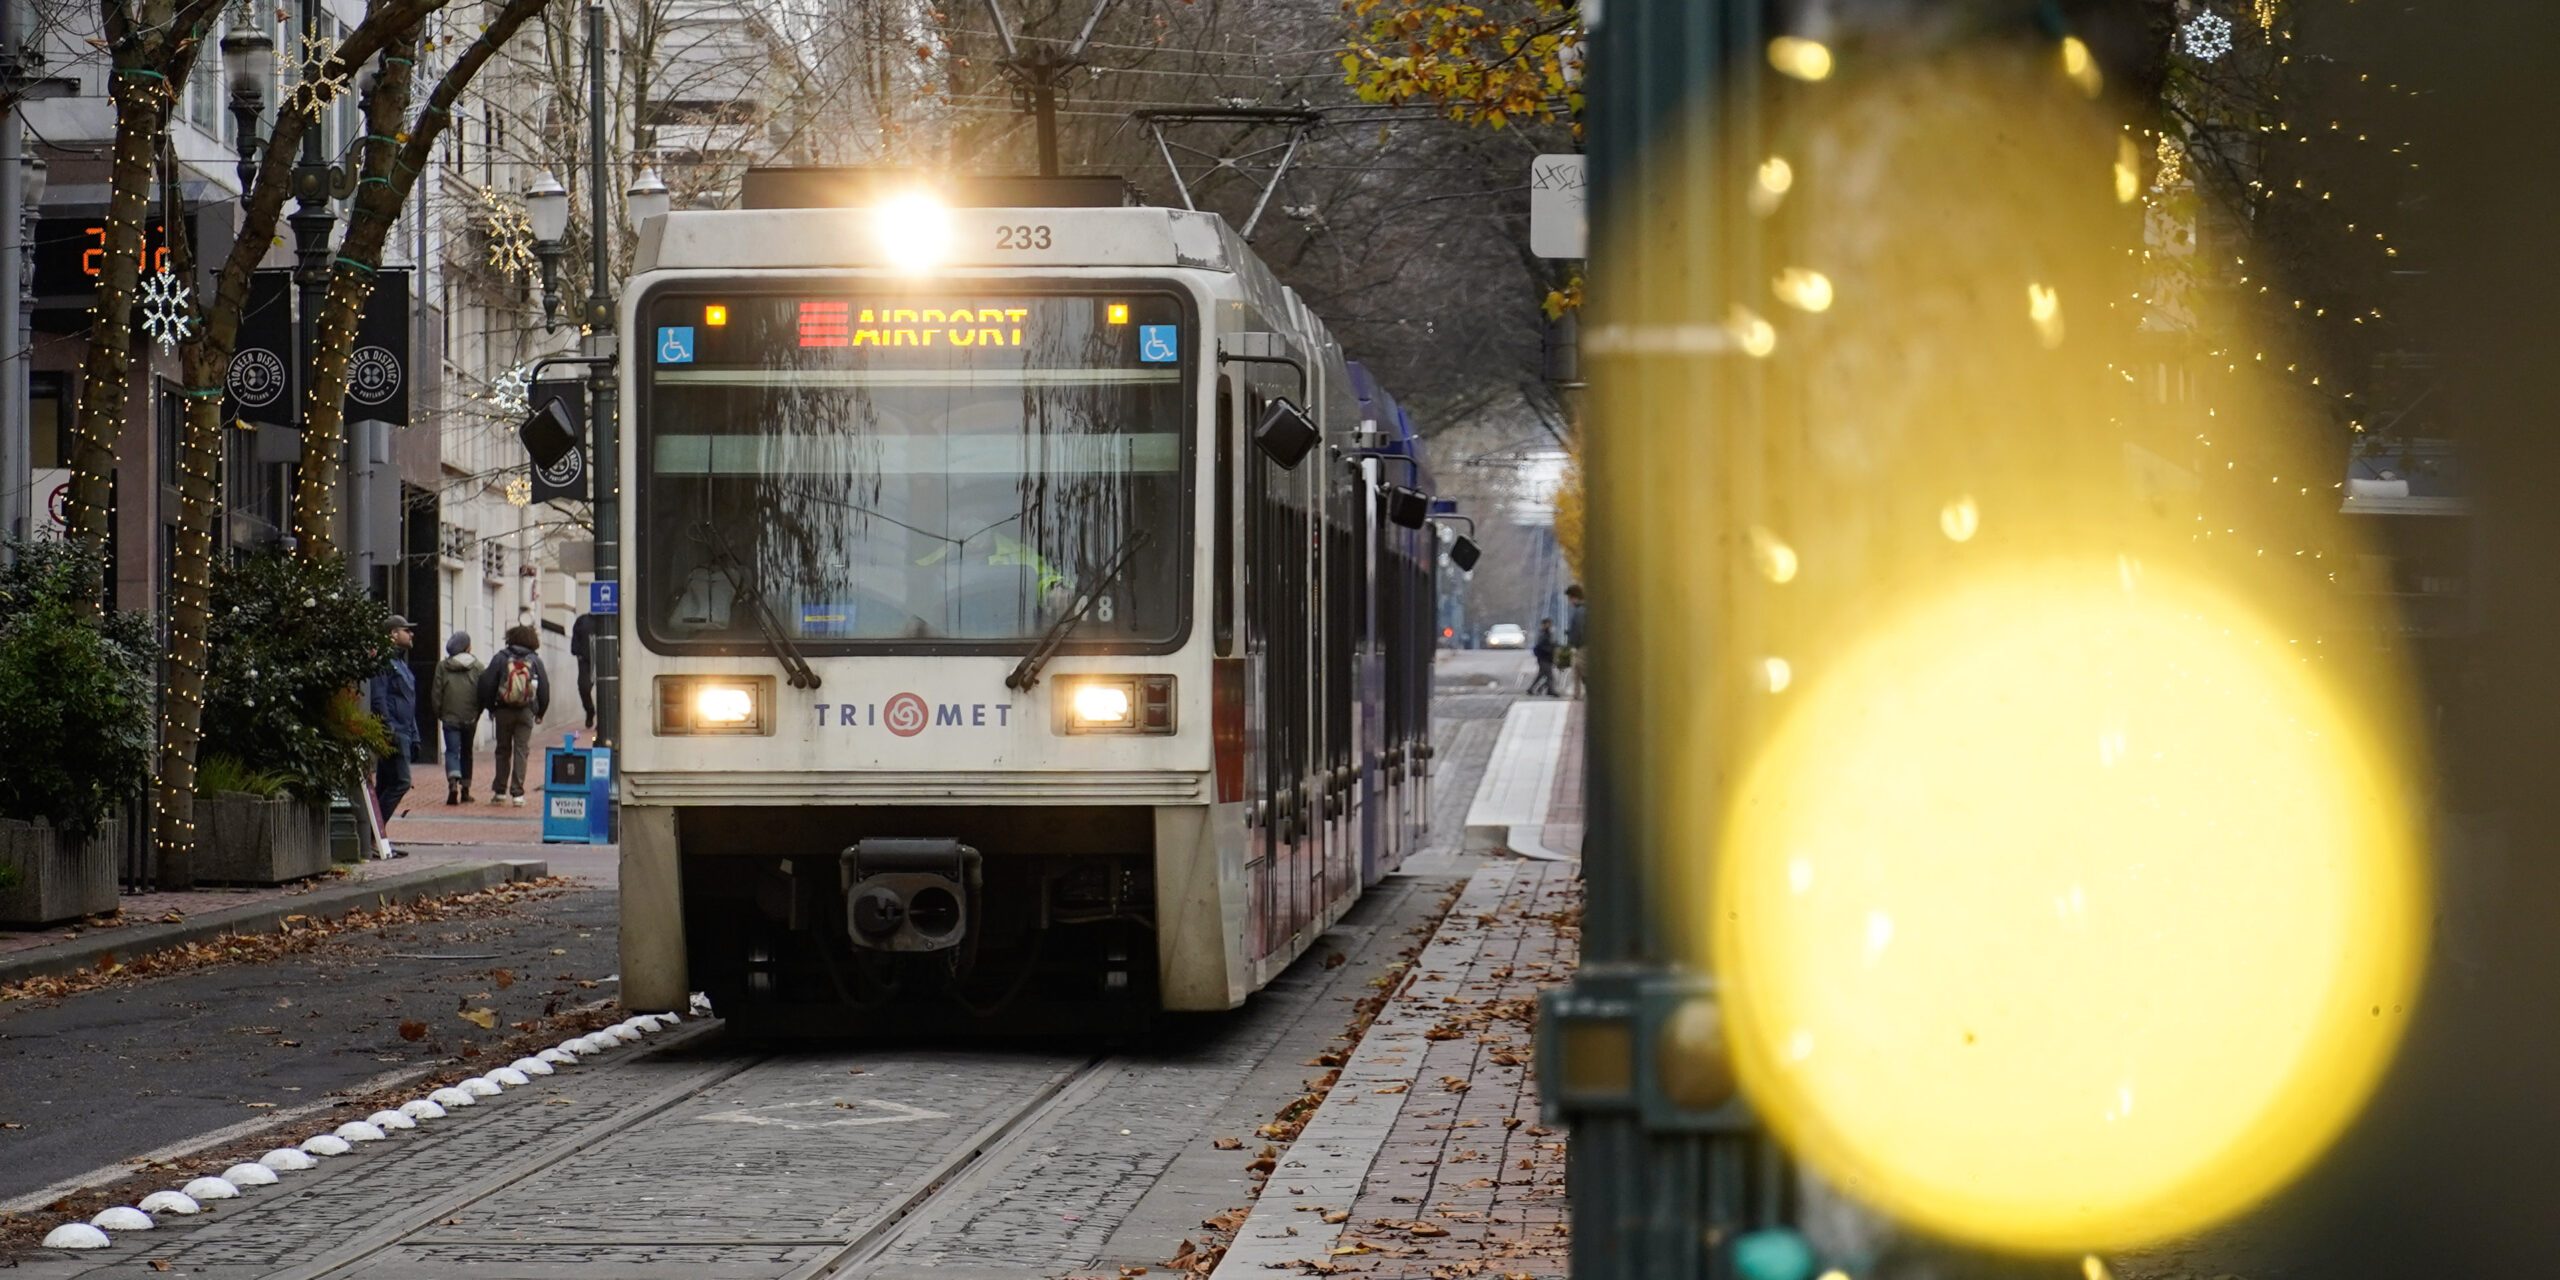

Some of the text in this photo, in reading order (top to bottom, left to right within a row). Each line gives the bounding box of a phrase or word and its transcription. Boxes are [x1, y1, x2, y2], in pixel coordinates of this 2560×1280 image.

[995, 225, 1052, 250] 233
[852, 309, 1028, 346] AIRPORT
[231, 352, 281, 387] PIONEER DISTRICT
[373, 350, 397, 385] DISTRICT
[814, 704, 1012, 726] TRI MET
[559, 807, 583, 816] TIMES
